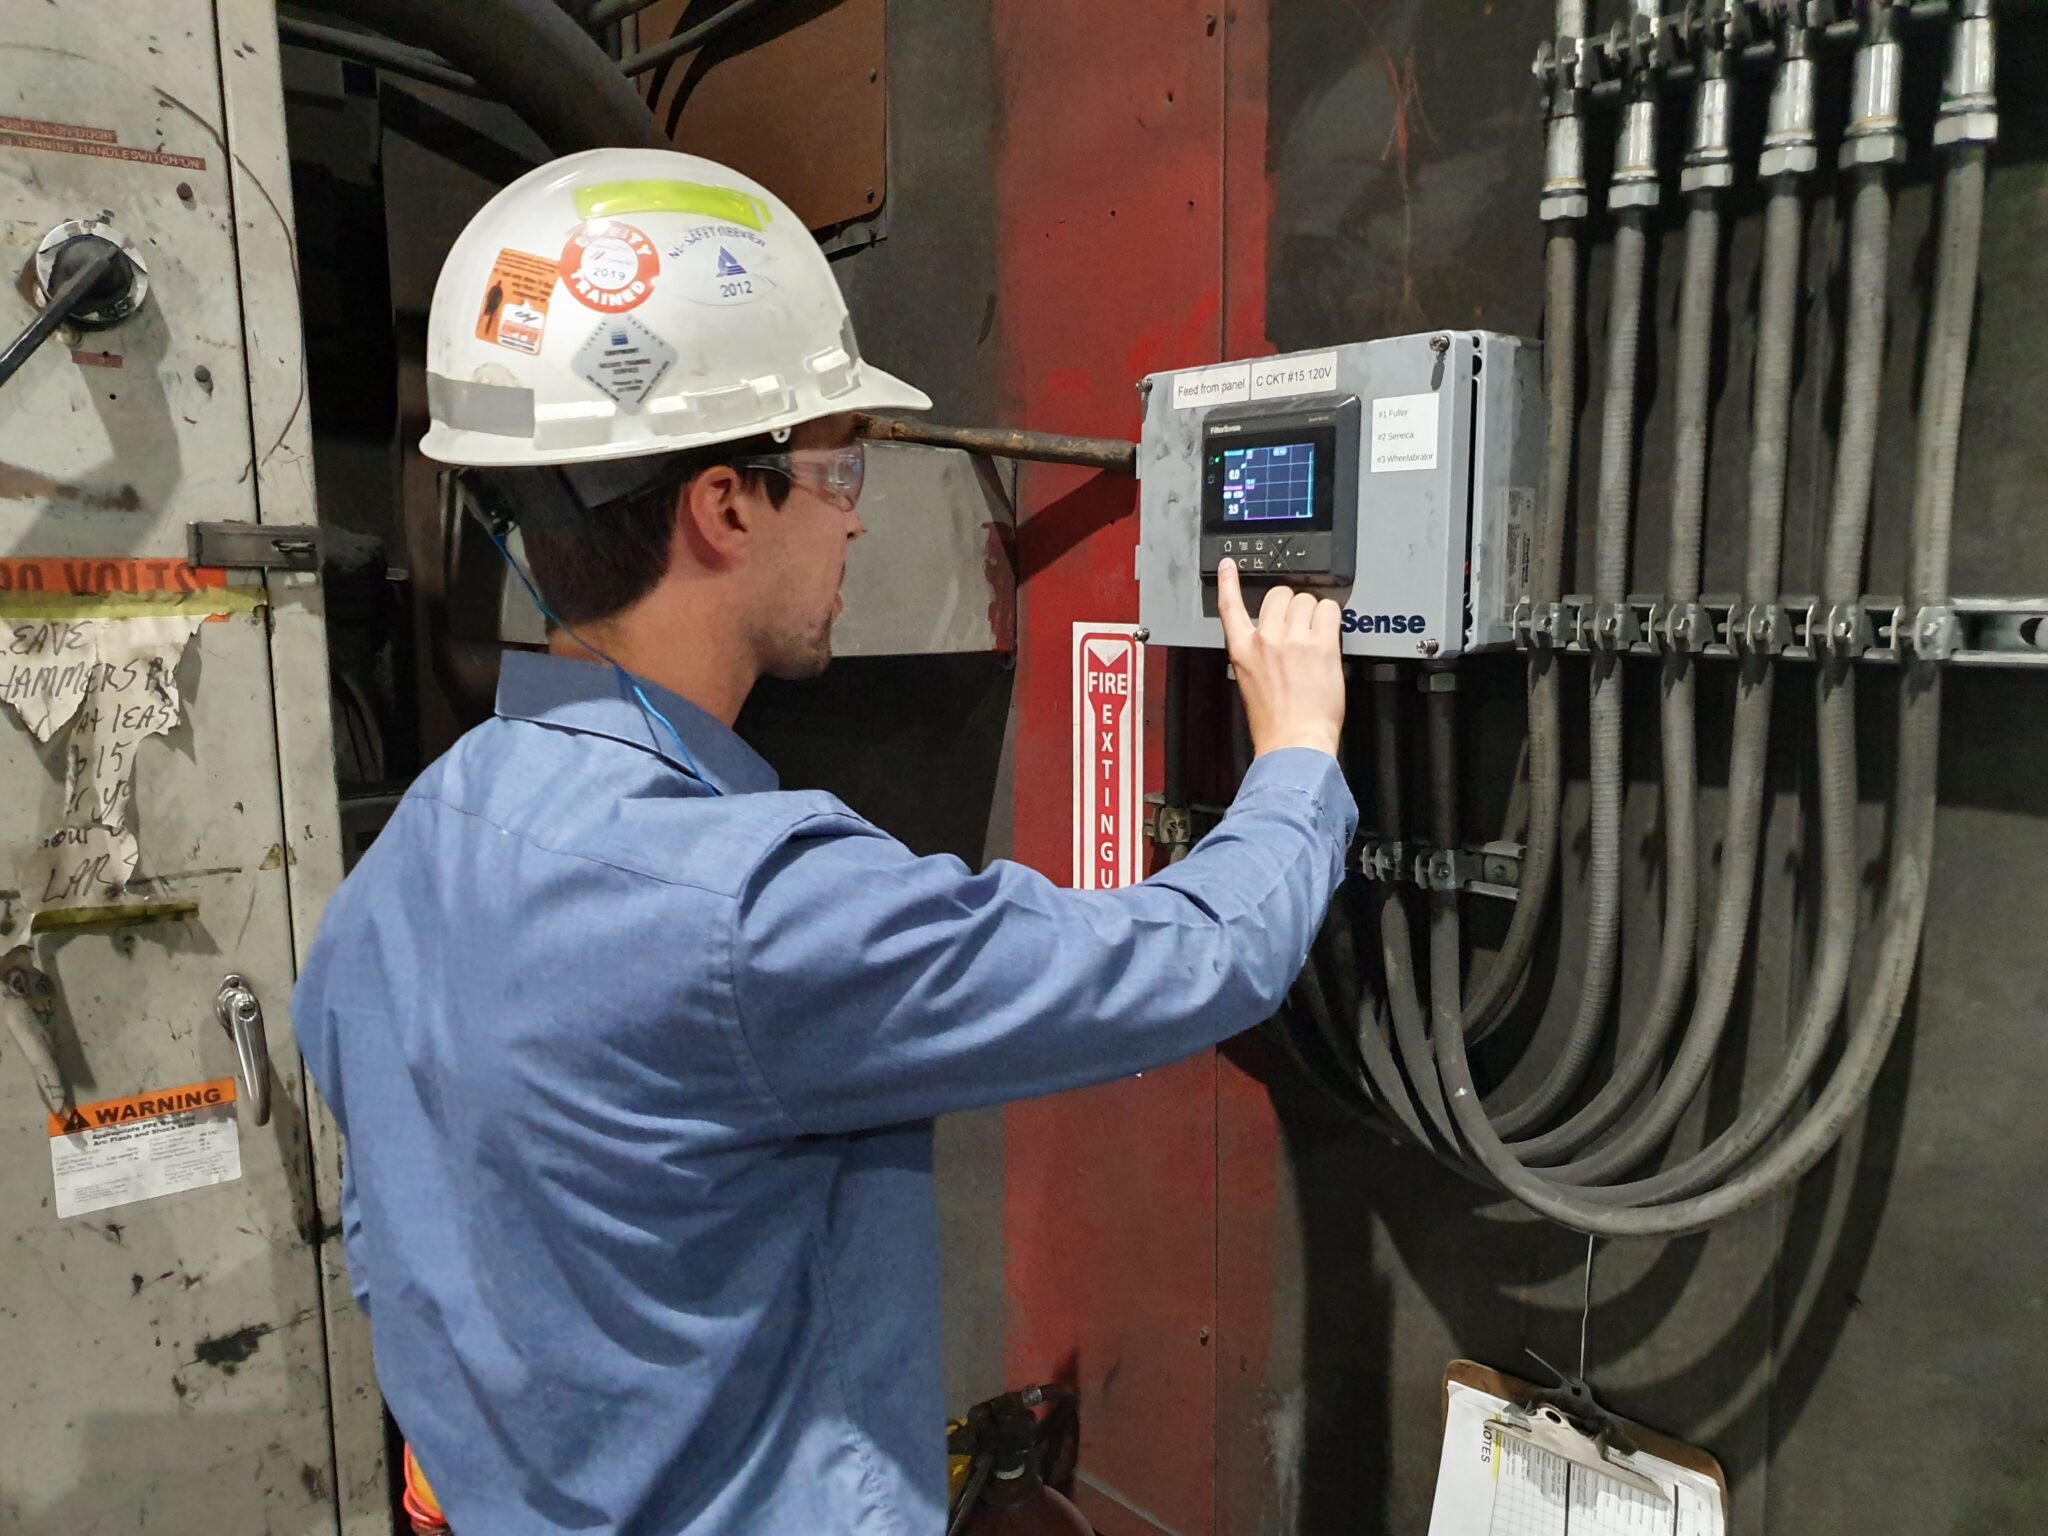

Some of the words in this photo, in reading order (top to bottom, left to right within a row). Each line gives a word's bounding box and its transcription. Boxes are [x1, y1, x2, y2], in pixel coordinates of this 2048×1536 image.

[18, 136, 74, 152] TURNING
[76, 128, 113, 141] DOOR
[593, 266, 626, 281] 2019
[570, 268, 646, 306] TRAINED
[720, 280, 753, 298] 2012
[1178, 384, 1199, 398] Feed
[1200, 382, 1220, 394] from
[1221, 378, 1245, 394] panel
[1256, 375, 1264, 387] C
[1265, 373, 1285, 386] CKT
[1287, 370, 1305, 383] #15
[1308, 366, 1332, 380] 120V
[1378, 410, 1387, 419] #1
[1387, 432, 1414, 441] Seneca
[1386, 453, 1434, 463] Wheelabrator
[0, 620, 93, 656] EAVE
[1088, 671, 1128, 695] FIRE
[1100, 704, 1114, 889] EXTINGU
[95, 1087, 221, 1125] WARNING
[94, 1138, 108, 1147] Arc
[110, 1134, 132, 1145] Flash
[134, 1130, 149, 1139] and
[152, 1126, 176, 1136] Shock
